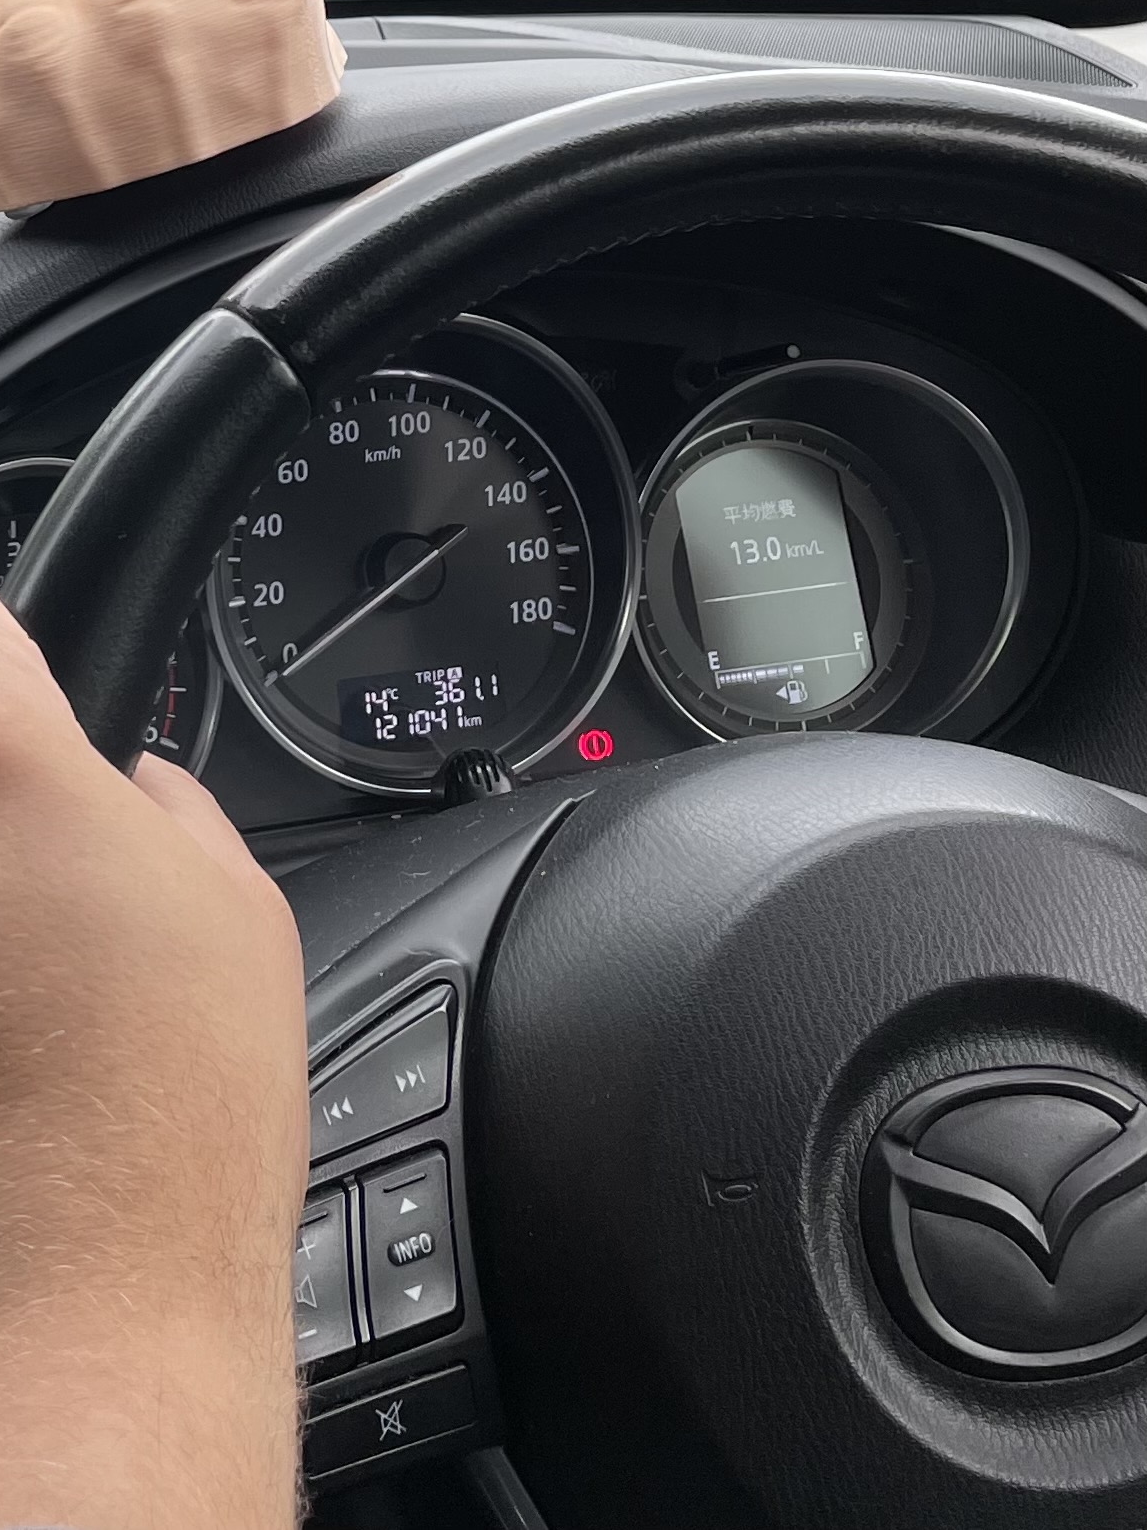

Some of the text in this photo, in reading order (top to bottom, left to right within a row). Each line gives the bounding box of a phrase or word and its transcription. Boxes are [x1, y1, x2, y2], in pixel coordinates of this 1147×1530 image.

[329, 420, 359, 445] 80
[389, 411, 430, 437] 100
[364, 445, 401, 463] km/h
[444, 436, 487, 462] 120
[277, 459, 309, 484] 60
[484, 481, 527, 507] 140
[252, 513, 283, 538] 40
[507, 537, 549, 564] 160
[730, 537, 781, 565] 13.0
[253, 581, 284, 607] 20
[510, 596, 552, 624] 180
[853, 632, 864, 650] F
[707, 651, 720, 670] E
[415, 669, 445, 684] TRIP
[394, 1233, 432, 1263] INFO
